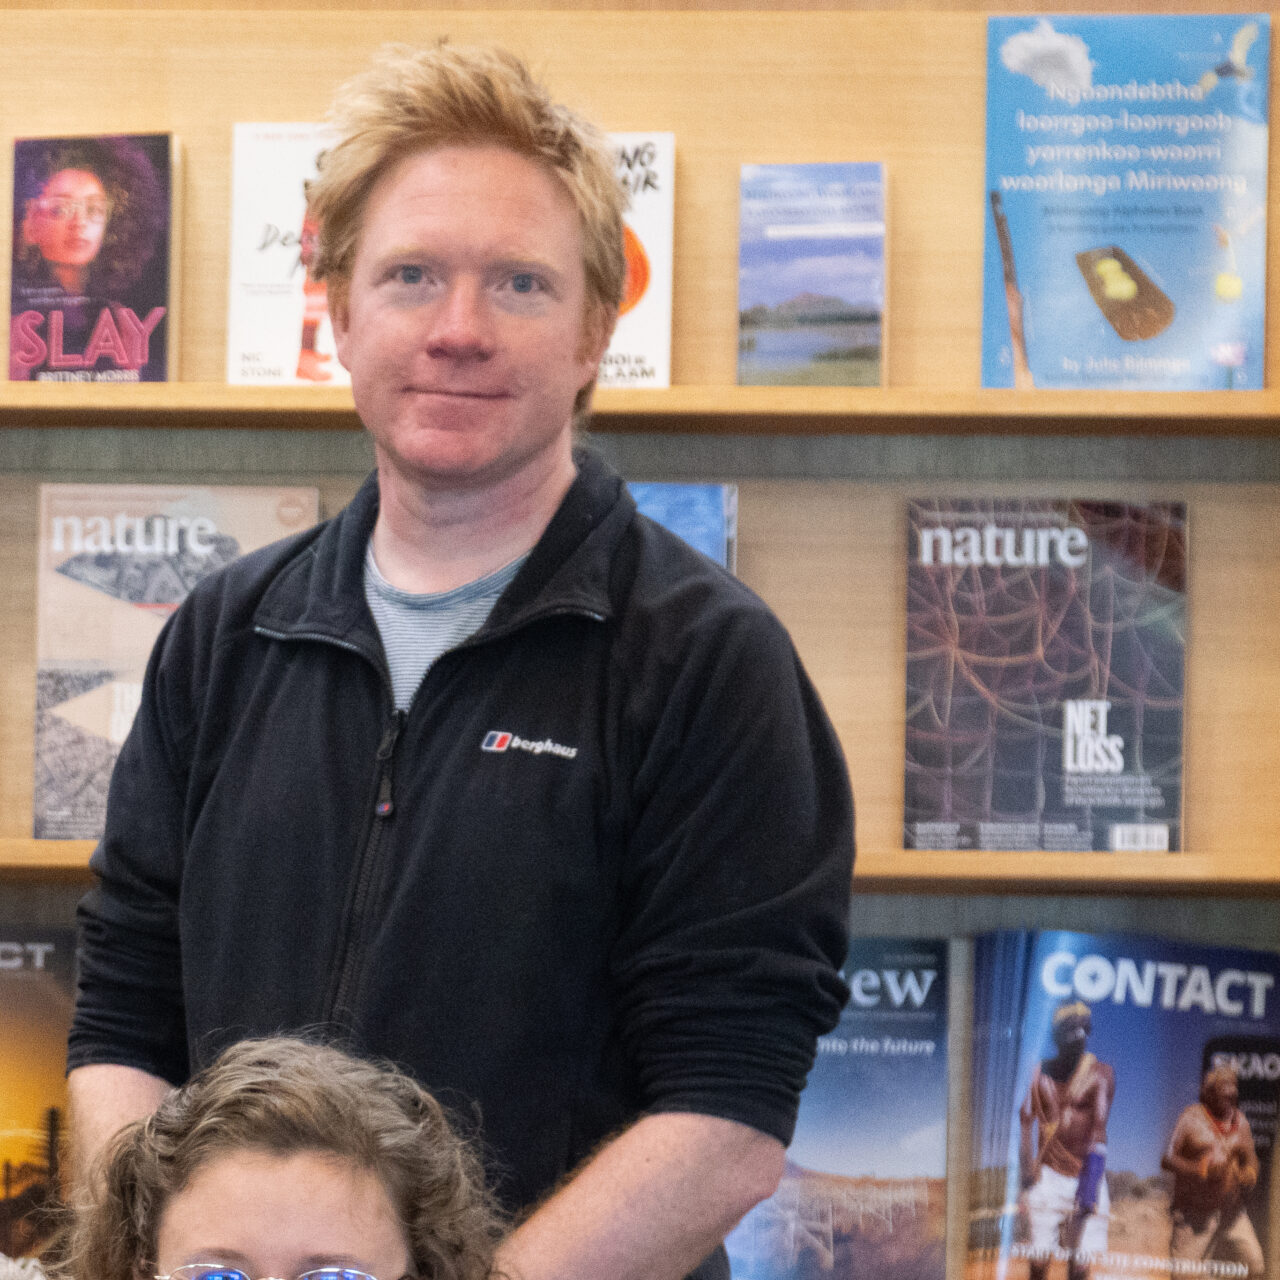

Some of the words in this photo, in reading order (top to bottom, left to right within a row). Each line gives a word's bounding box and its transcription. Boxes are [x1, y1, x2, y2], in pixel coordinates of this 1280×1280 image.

[15, 306, 167, 369] SLAY
[52, 511, 218, 555] nature
[920, 524, 1089, 569] nature
[1064, 699, 1112, 736] NET
[511, 735, 578, 759] berghaus
[1064, 735, 1124, 774] LOSS
[1041, 952, 1275, 1019] CONTACT
[850, 1036, 880, 1054] the
[883, 1036, 936, 1056] future
[1132, 1253, 1250, 1278] CONSTRUCTION
